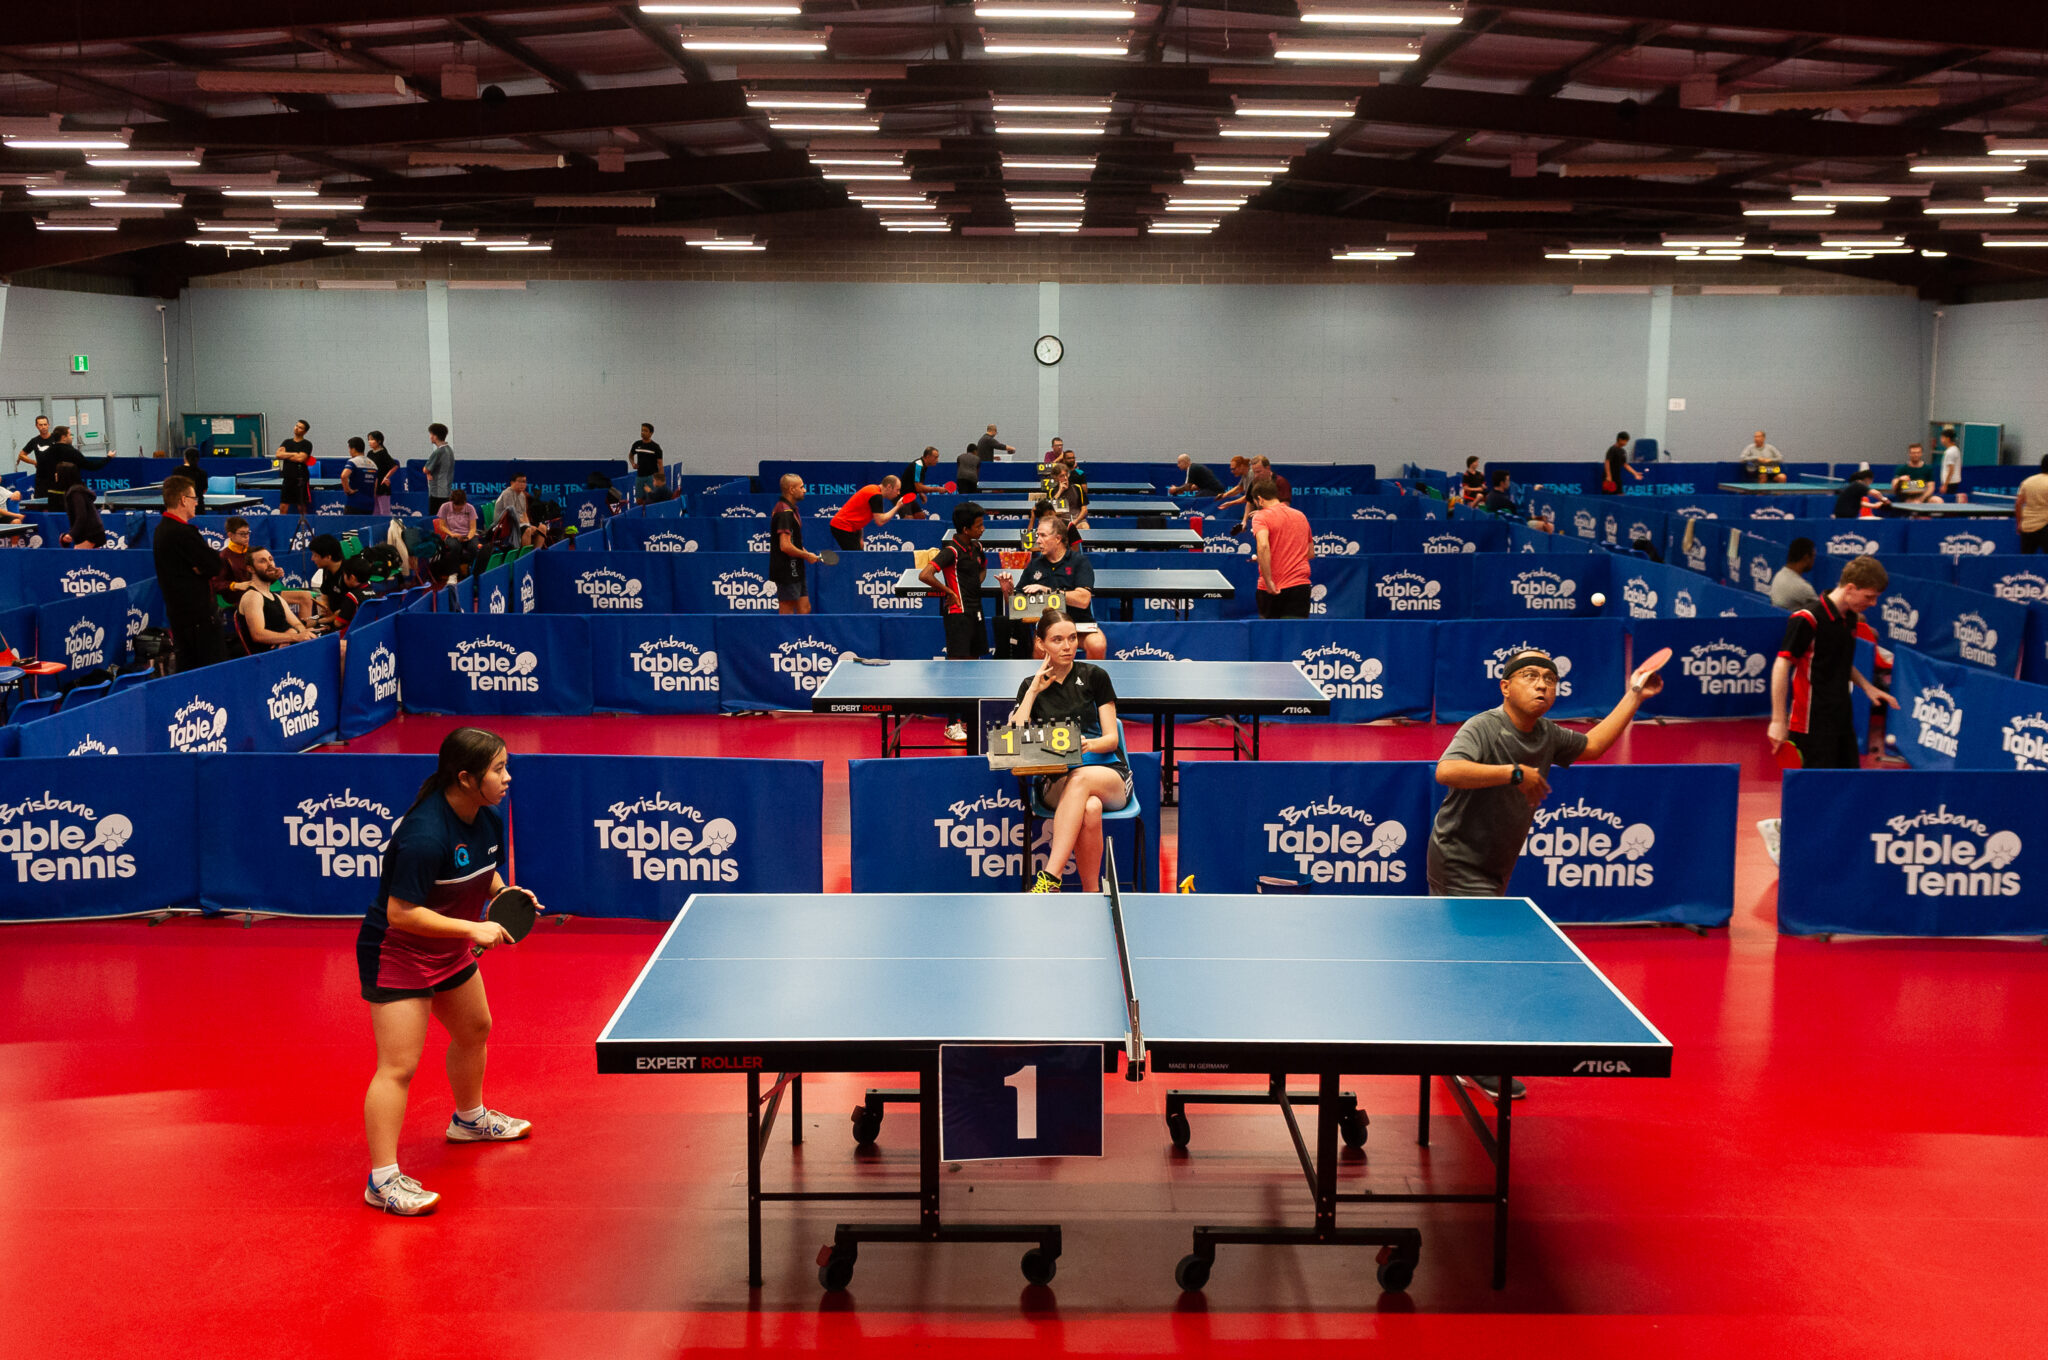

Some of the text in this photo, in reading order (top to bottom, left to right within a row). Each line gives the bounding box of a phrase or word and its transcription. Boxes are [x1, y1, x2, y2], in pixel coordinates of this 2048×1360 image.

[96, 479, 130, 490] TENNIS
[818, 484, 857, 494] TENNIS
[643, 541, 682, 552] Table
[648, 530, 686, 543] Brisbane
[747, 540, 771, 552] Tab
[753, 532, 771, 541] Bris
[863, 541, 898, 552] Table
[867, 532, 902, 544] Brisbane
[1204, 543, 1235, 553] able
[1314, 542, 1344, 555] able
[1422, 542, 1460, 554] Table
[1826, 542, 1863, 555] Table
[1939, 542, 1979, 554] Table
[66, 565, 110, 580] Brisbane
[582, 566, 627, 581] Brisbane
[719, 568, 764, 582] Brisbane
[862, 567, 902, 581] Brisban
[1382, 569, 1426, 584] Brisbane
[1518, 568, 1562, 581] Brisbane
[60, 578, 107, 593] Table
[575, 580, 622, 595] Table
[712, 581, 759, 595] Table
[1375, 582, 1421, 597] Table
[1510, 580, 1557, 595] Table
[1993, 583, 2041, 598] Table
[590, 594, 643, 609] Tennis
[727, 595, 779, 609] Tennis
[871, 595, 923, 609] Tennis
[1014, 596, 1026, 610] 0
[1048, 594, 1060, 610] 0
[1389, 597, 1441, 611] Tennis
[1524, 594, 1576, 609] Tennis
[64, 632, 92, 655] Table
[1953, 621, 1983, 646] Table
[456, 634, 517, 655] Brisbane
[639, 635, 700, 655] Brisbane
[779, 635, 839, 655] Brisbane
[1115, 642, 1175, 661] Brisbane
[1302, 642, 1362, 662] Brisbane
[1690, 638, 1748, 658] Brisbane
[1960, 641, 1997, 667] Tennis
[71, 649, 103, 670] Tennis
[448, 652, 510, 672] Table
[630, 652, 694, 672] Table
[770, 653, 833, 672] Table
[1681, 656, 1741, 676] Table
[368, 660, 390, 686] Table
[467, 671, 539, 692] Tennis
[651, 672, 720, 691] Tennis
[272, 671, 306, 697] Brisbane
[374, 677, 397, 702] Tennis
[1699, 676, 1765, 694] Tennis
[175, 695, 215, 724] Brisbane
[267, 692, 302, 720] Table
[1912, 696, 1950, 730] Table
[168, 717, 211, 748] Table
[280, 710, 319, 738] Tennis
[1001, 728, 1070, 754] 1 1 1 8
[1918, 722, 1958, 758] Tennis
[2002, 726, 2048, 763] Table
[0, 791, 97, 824] Brisbane
[298, 788, 393, 820] Brisbane
[608, 791, 704, 823] Brisbane
[948, 789, 1025, 821] Brisba
[1278, 795, 1375, 827] Brisbane
[1533, 797, 1624, 830] Brisbane
[1887, 804, 1989, 836] Brisbane
[0, 820, 84, 853] able
[284, 816, 382, 847] Table
[594, 819, 693, 850] Table
[934, 817, 1031, 848] Table
[1264, 823, 1363, 854] Table
[1870, 833, 1977, 866] Table
[12, 852, 136, 882] Tennis
[316, 847, 382, 877] Ten
[627, 850, 739, 882] Tennis
[966, 848, 1077, 877] Tenns
[1294, 853, 1407, 883] Tennis
[1543, 857, 1654, 887] Tennis
[1903, 865, 2021, 896] Tennis
[636, 1056, 763, 1070] EXPERT ROLLER
[1573, 1060, 1632, 1073] STIGA
[1003, 1065, 1038, 1139] 1
